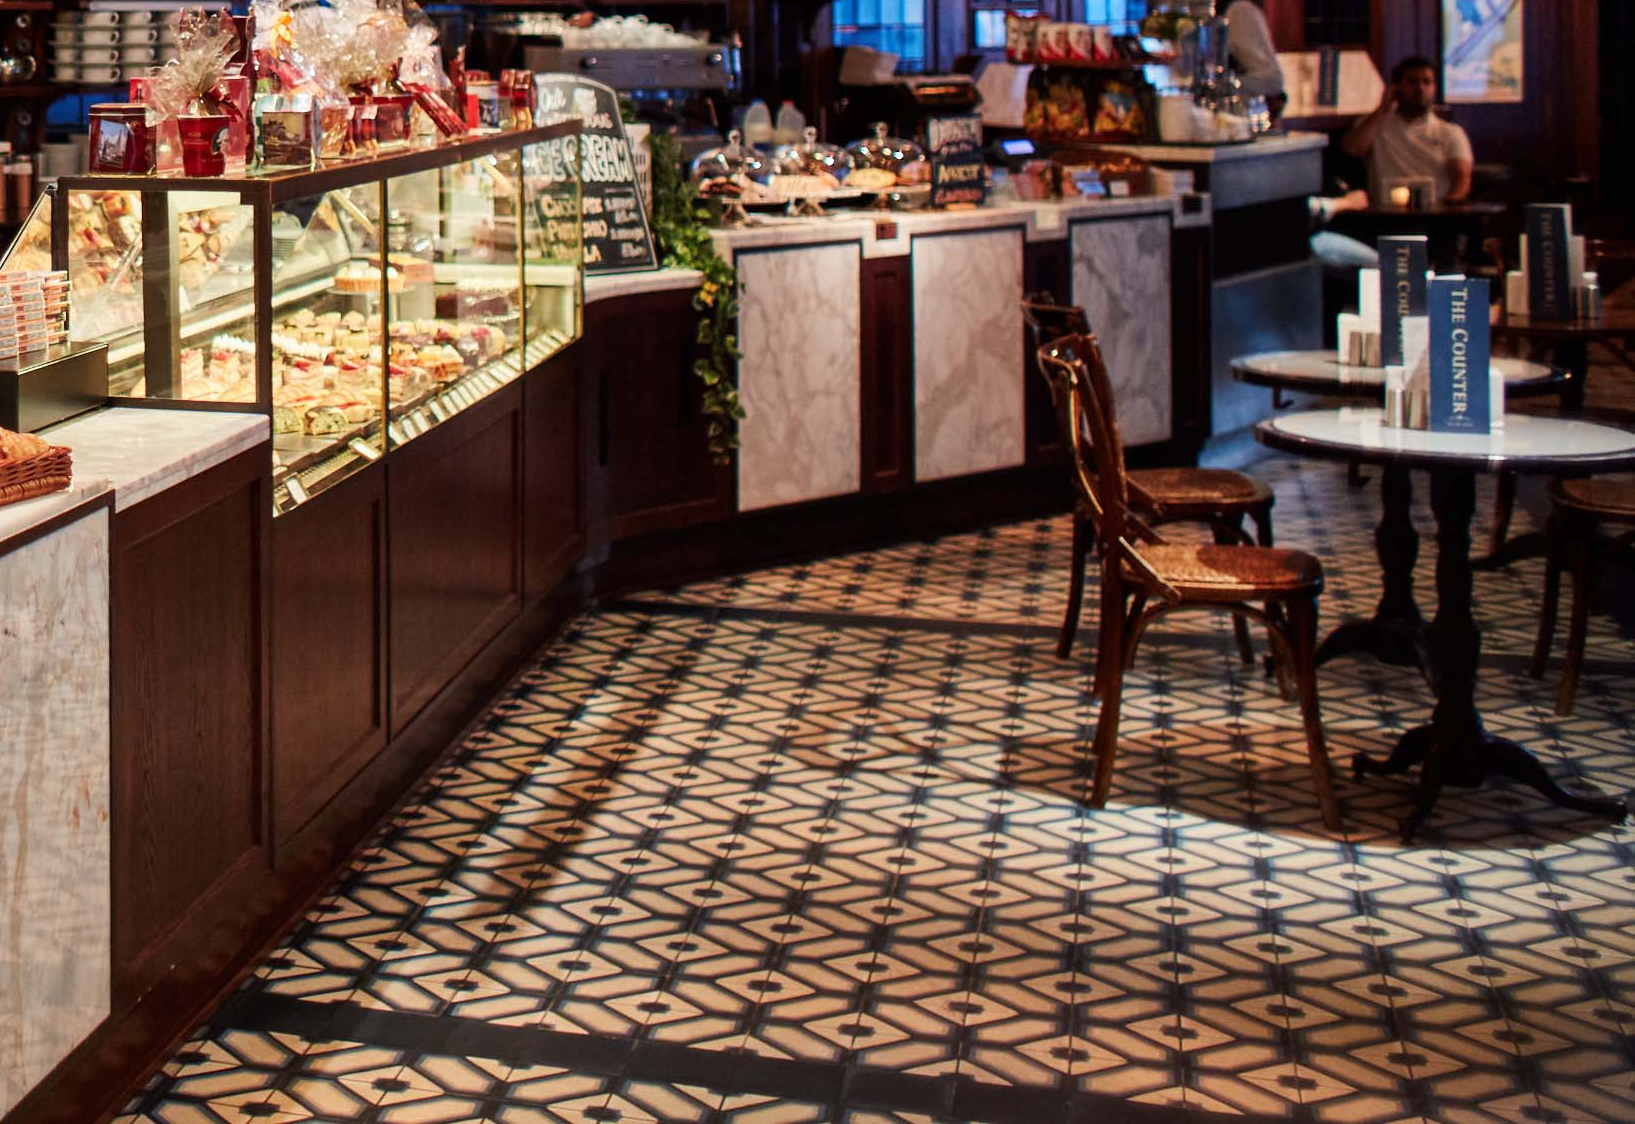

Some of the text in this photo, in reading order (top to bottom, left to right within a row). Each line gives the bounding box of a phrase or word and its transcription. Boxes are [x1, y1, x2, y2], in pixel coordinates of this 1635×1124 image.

[1397, 246, 1410, 274] THE
[1451, 288, 1469, 323] THE
[1452, 328, 1469, 413] COUNTER
